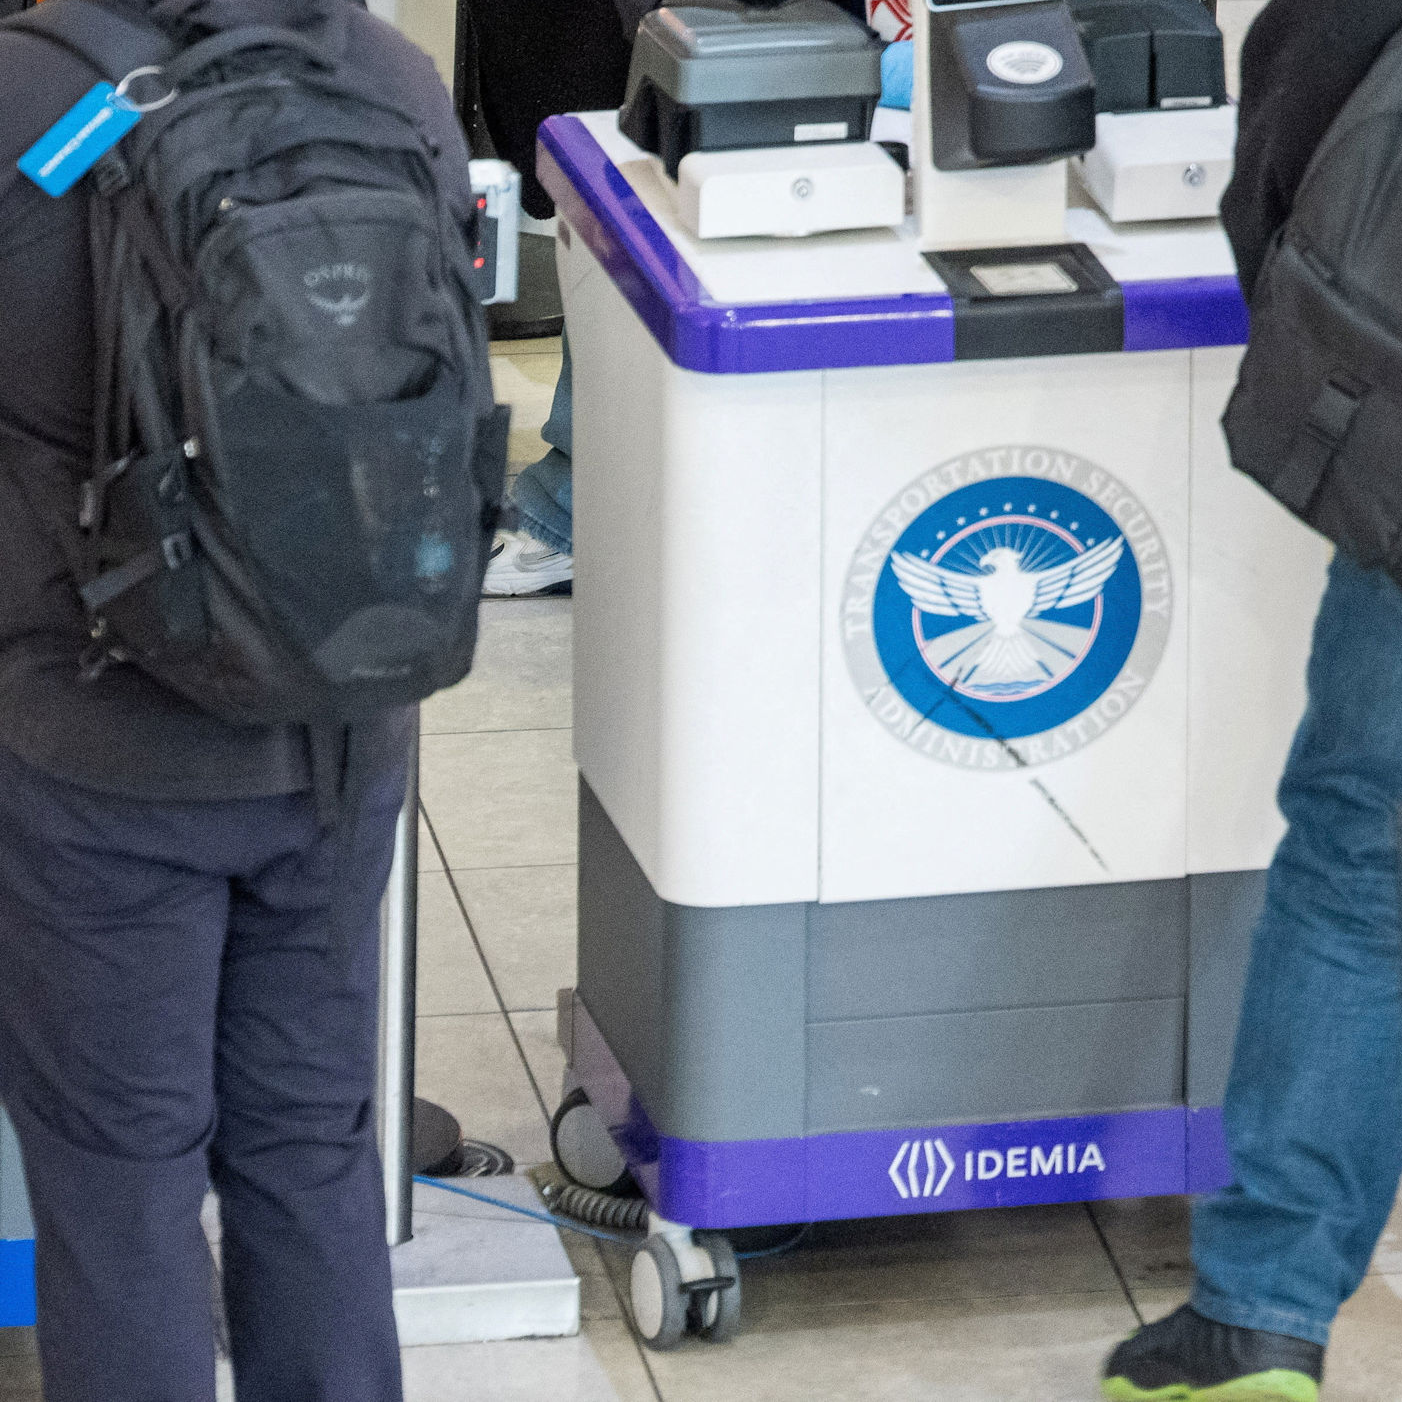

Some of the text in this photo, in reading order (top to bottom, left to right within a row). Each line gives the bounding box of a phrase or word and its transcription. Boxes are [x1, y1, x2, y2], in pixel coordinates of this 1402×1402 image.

[844, 449, 1170, 640] TRANSPORTATION SECURITY
[964, 1141, 1106, 1181] IDEMIA
